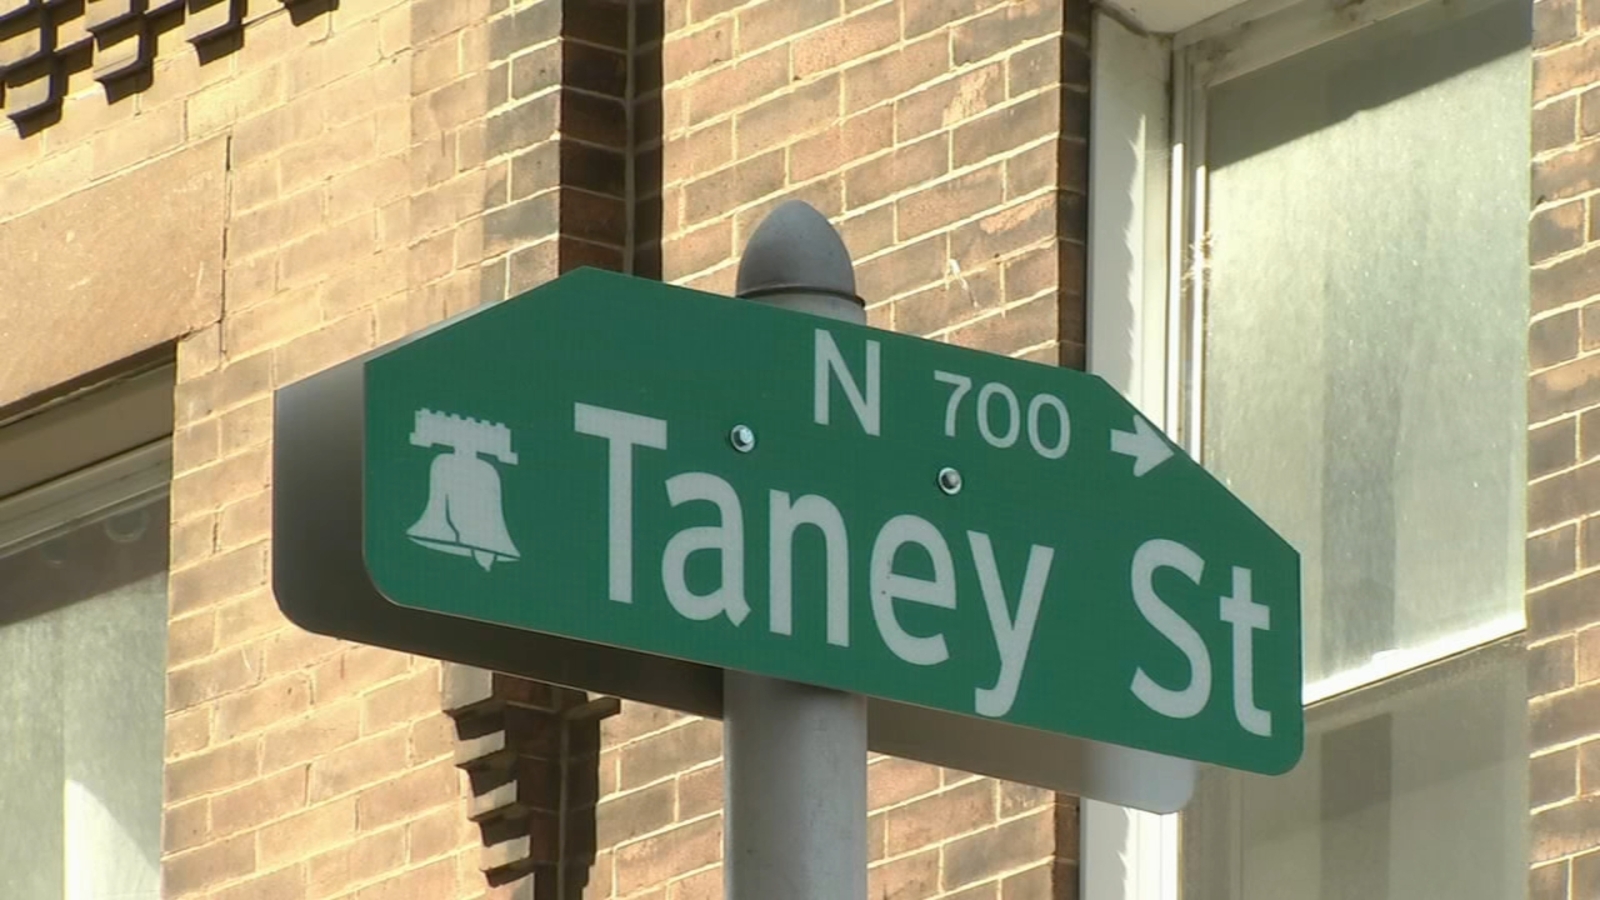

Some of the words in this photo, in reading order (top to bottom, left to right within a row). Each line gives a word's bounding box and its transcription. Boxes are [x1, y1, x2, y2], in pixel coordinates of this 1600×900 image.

[814, 329, 881, 436] N
[934, 371, 1071, 459] 700
[574, 403, 1054, 718] Taney
[1130, 539, 1272, 736] St
